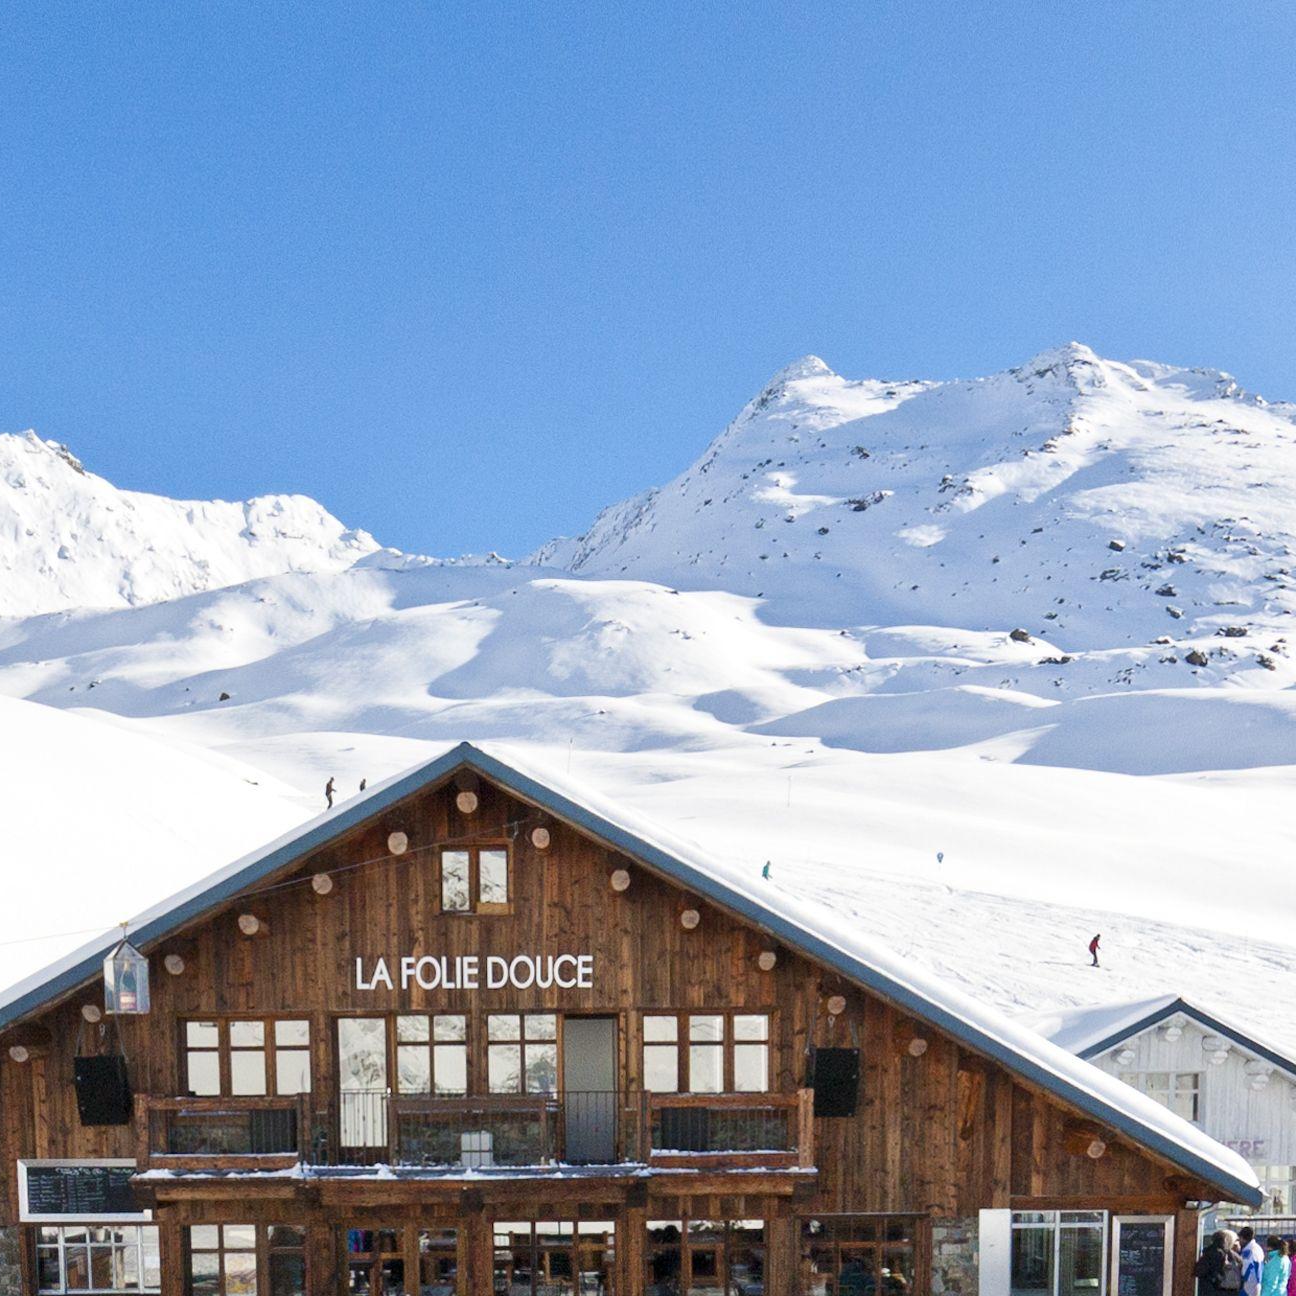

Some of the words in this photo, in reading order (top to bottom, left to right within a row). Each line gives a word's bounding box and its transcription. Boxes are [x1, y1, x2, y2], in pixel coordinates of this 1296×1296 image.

[355, 957, 394, 990] LA
[401, 955, 479, 990] FOLIE
[486, 954, 594, 989] DOUCE
